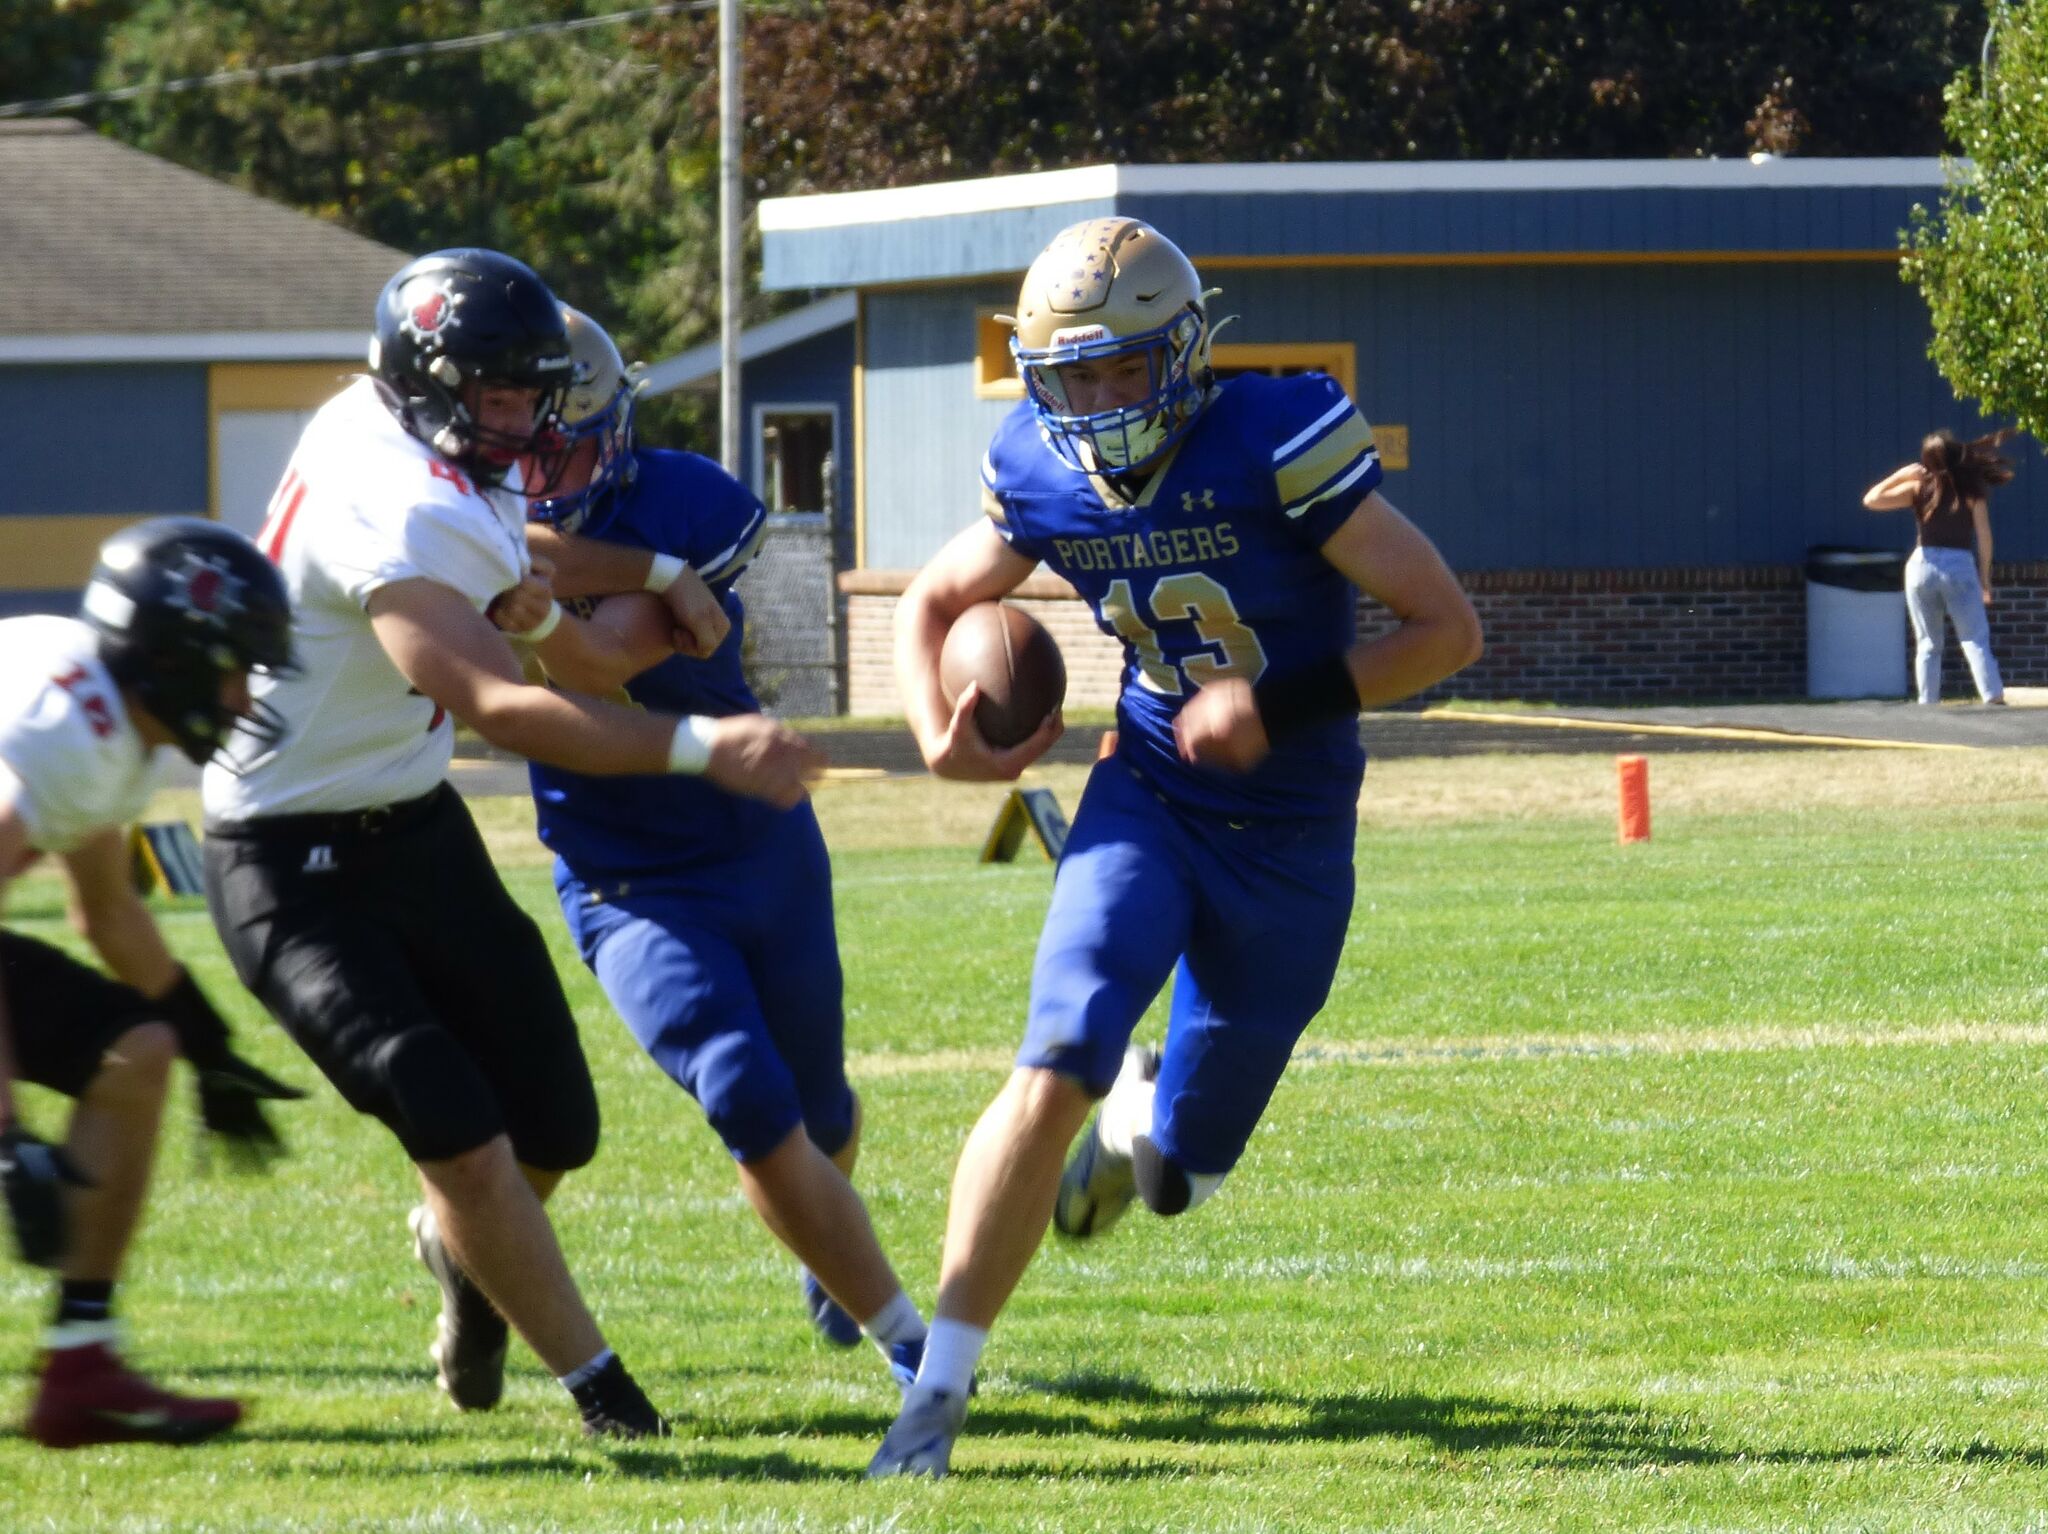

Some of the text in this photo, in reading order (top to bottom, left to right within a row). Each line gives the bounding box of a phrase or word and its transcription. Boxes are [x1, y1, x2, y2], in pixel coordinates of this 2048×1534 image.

[1057, 329, 1104, 346] Riddell
[1052, 522, 1241, 570] PORTAGERS
[1099, 571, 1269, 697] 13
